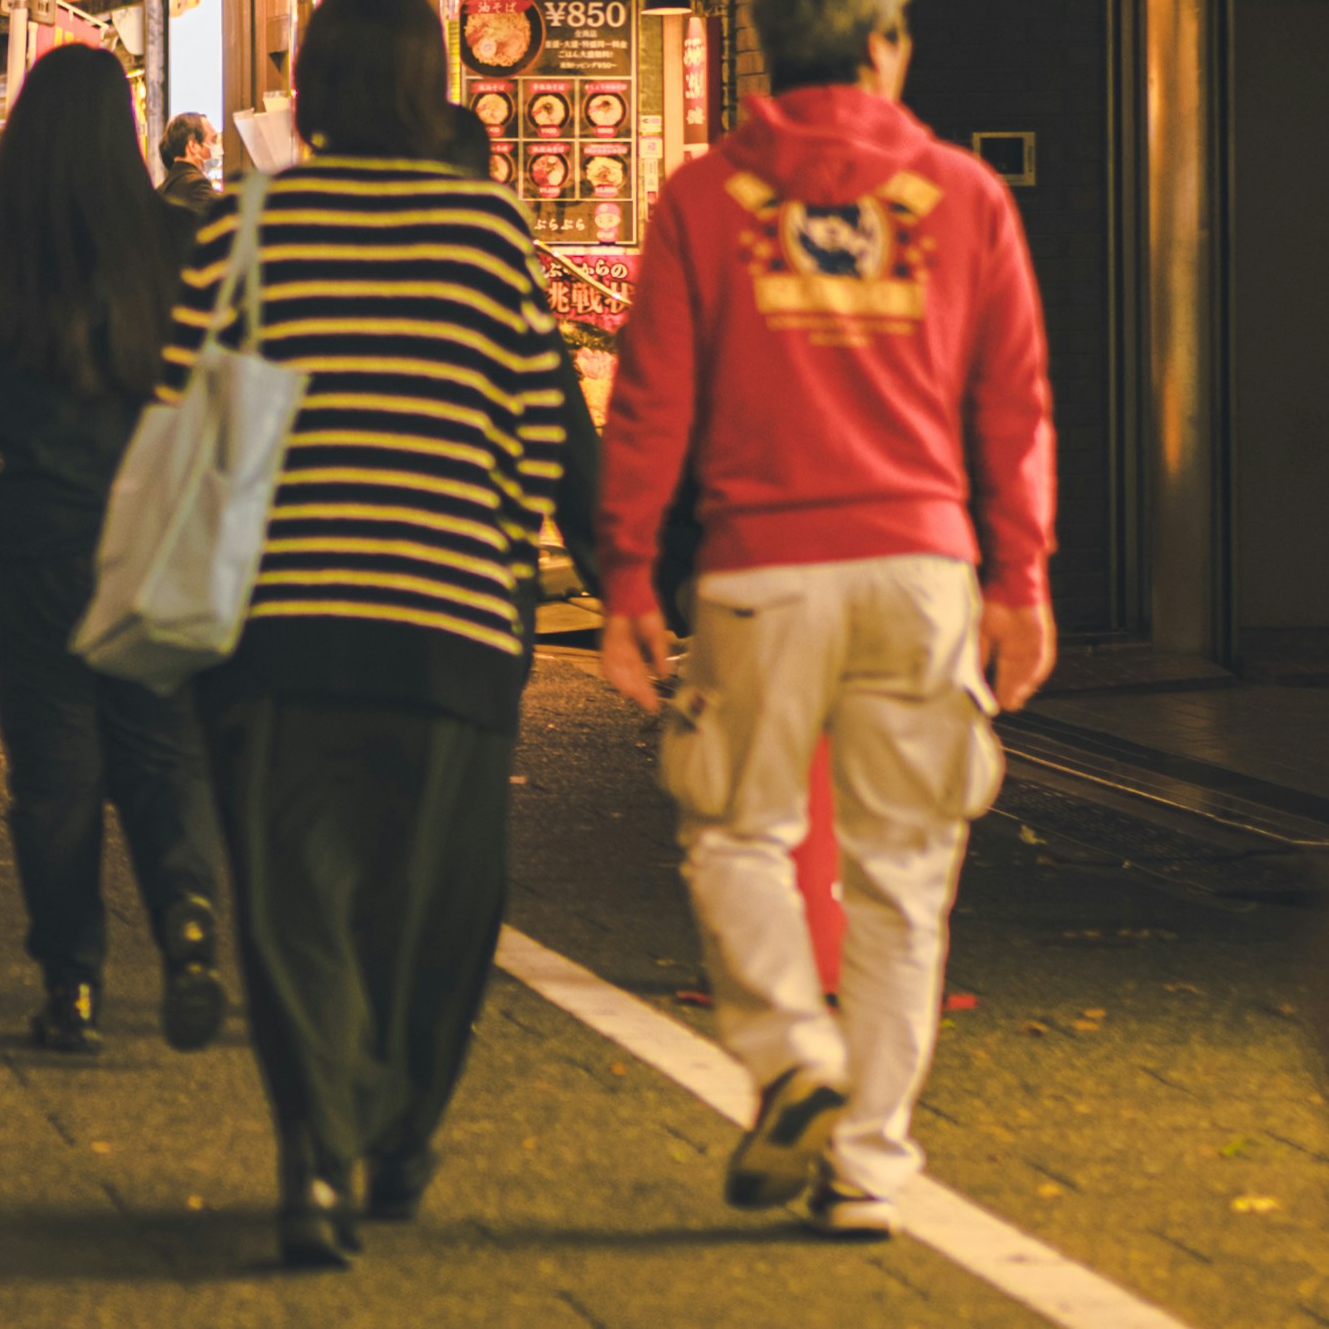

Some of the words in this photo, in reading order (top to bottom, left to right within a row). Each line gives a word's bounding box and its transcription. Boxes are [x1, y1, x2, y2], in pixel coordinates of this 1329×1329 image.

[477, 1, 518, 14] 油そば
[543, 0, 627, 29] ¥850
